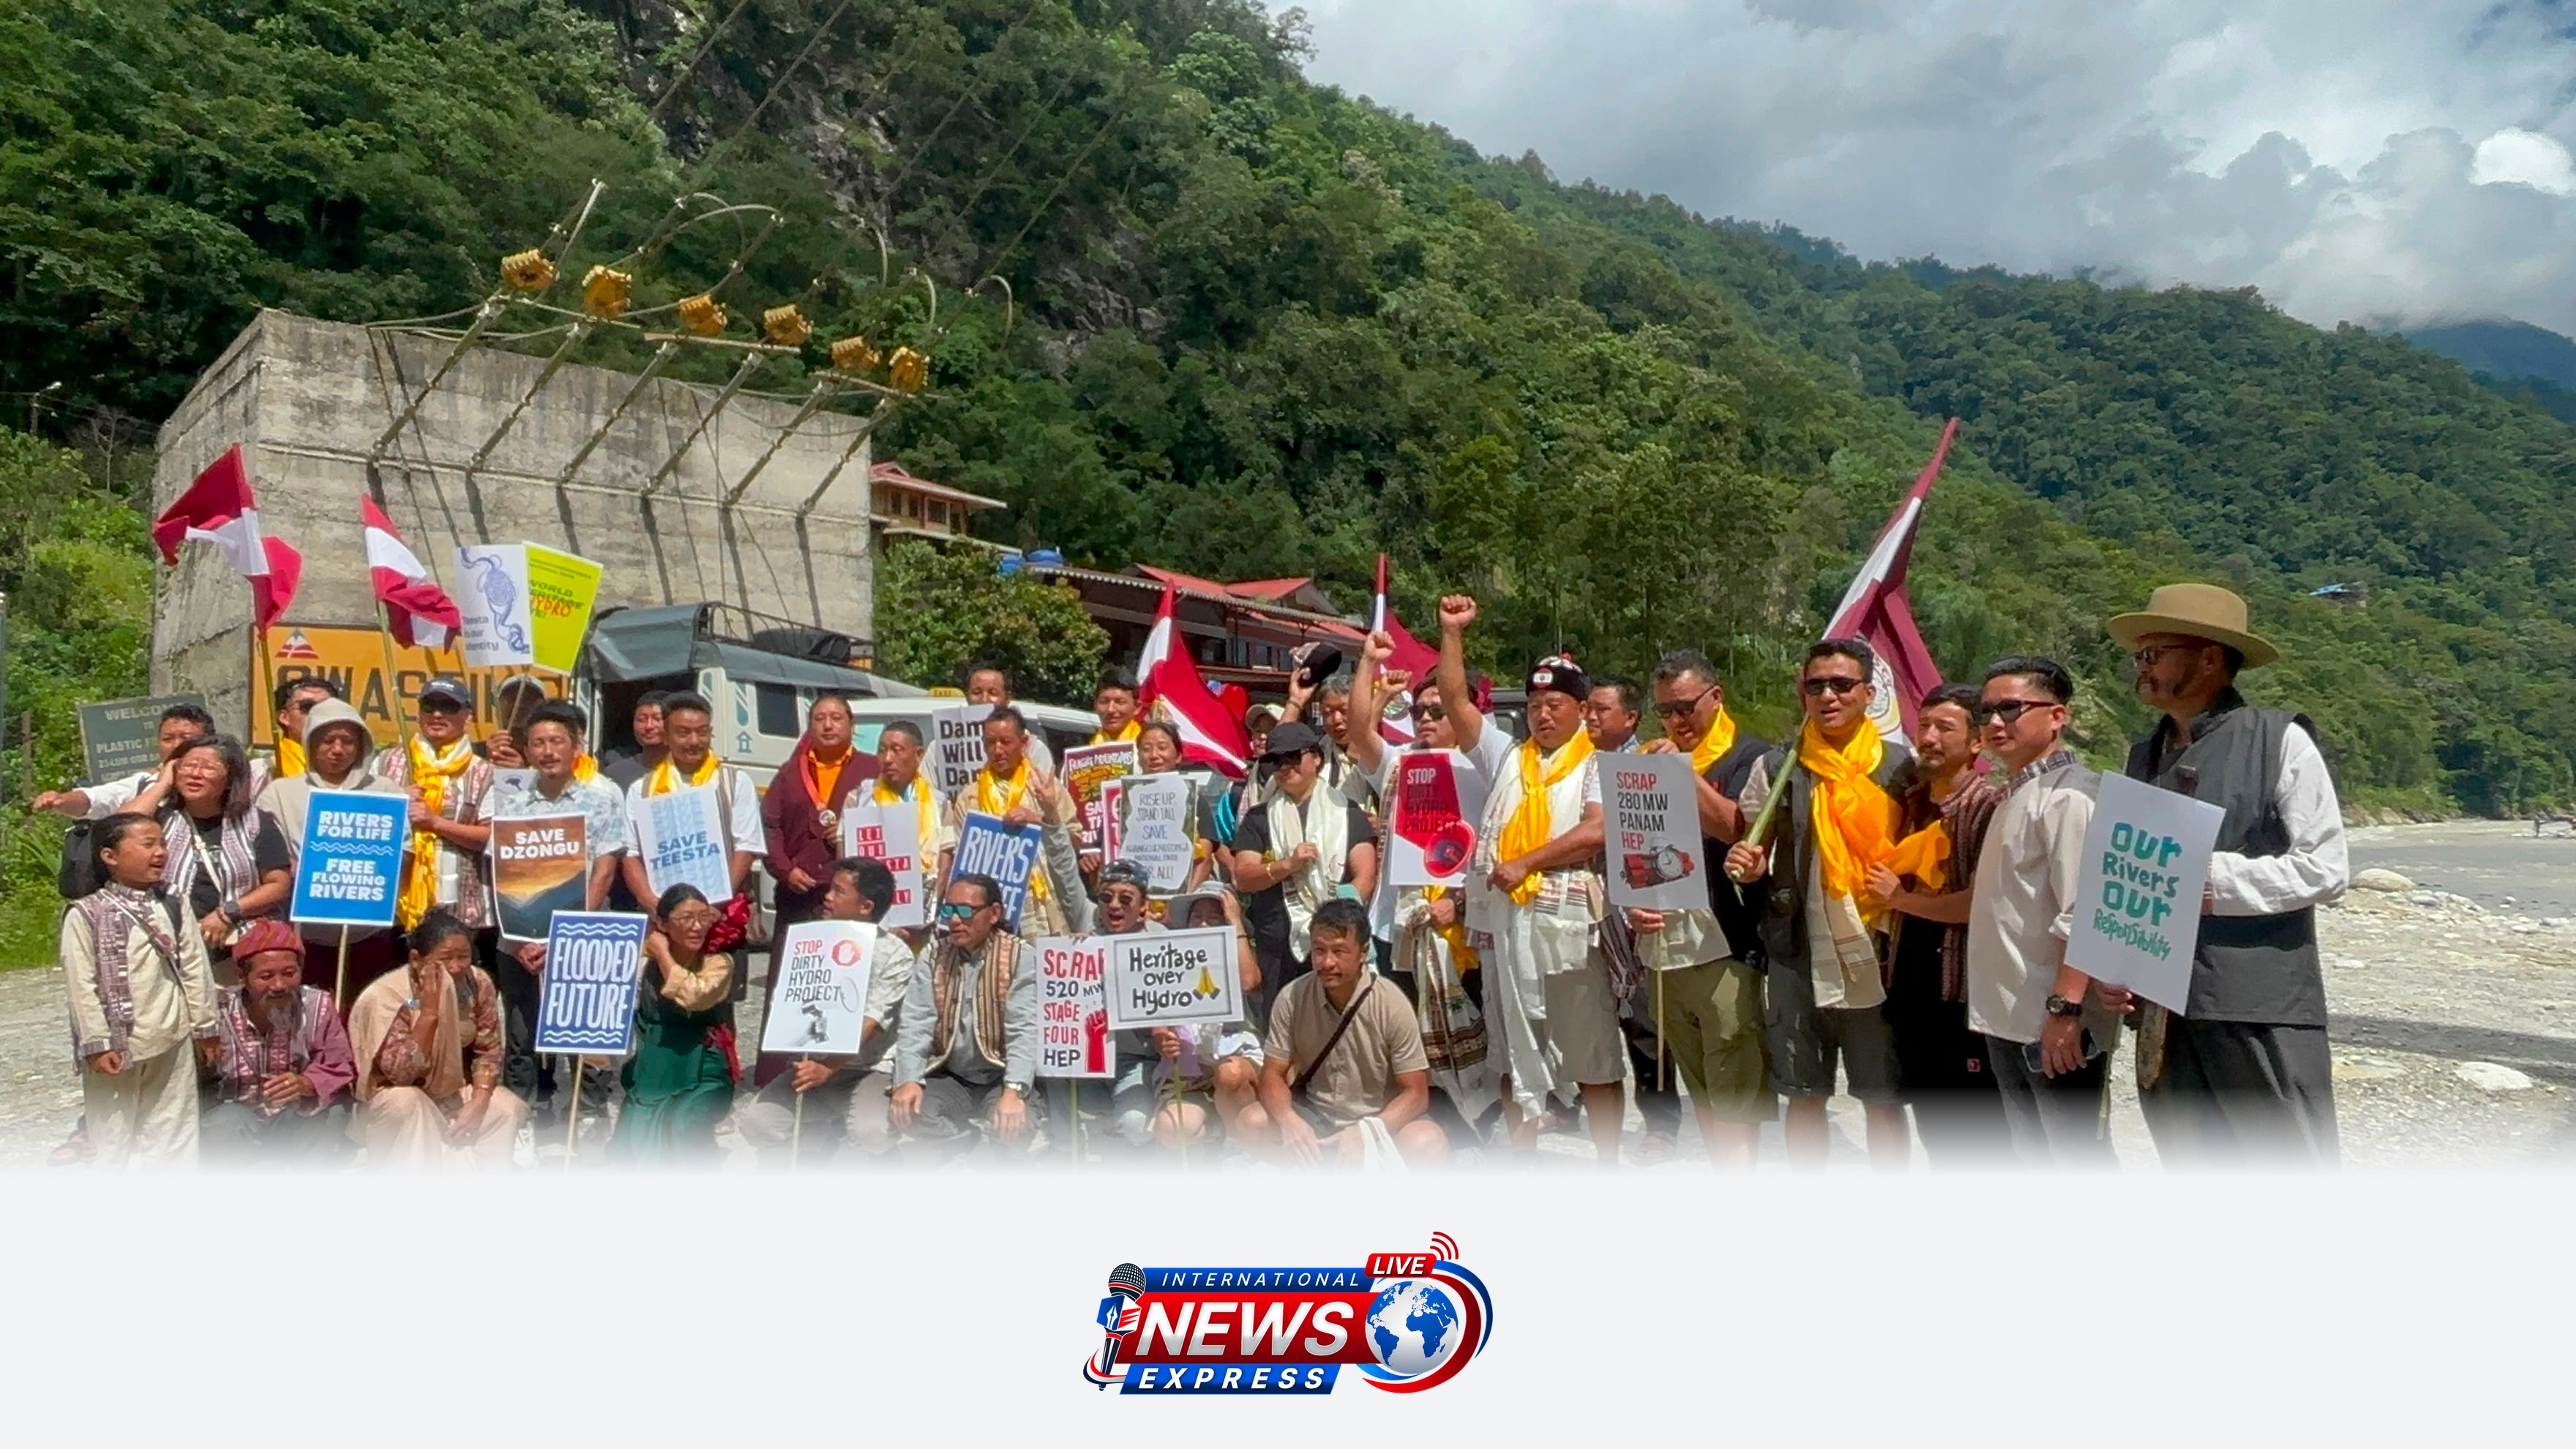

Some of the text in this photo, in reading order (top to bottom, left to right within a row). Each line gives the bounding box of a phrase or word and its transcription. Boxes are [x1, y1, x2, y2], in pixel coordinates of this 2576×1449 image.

[105, 703, 175, 721] WELCO
[96, 738, 143, 754] PLASTIC
[943, 741, 983, 763] Will
[1407, 768, 1437, 785] STOP
[1616, 771, 1657, 790] SCRAP
[1617, 792, 1669, 811] 280 MW
[318, 810, 393, 828] RIVERS
[1161, 807, 1175, 821] TALL
[1620, 812, 1665, 831] PANAM
[317, 825, 391, 841] FOR LIFE
[1142, 825, 1168, 839] SAVE
[1402, 816, 1459, 834] PROJECT
[515, 828, 564, 844] SAVE
[657, 831, 708, 854] SAVE
[858, 828, 881, 841] LET
[1621, 831, 1644, 850] HEP
[500, 842, 580, 860] DZONGU
[650, 842, 720, 870] TEESTA
[326, 857, 376, 875] FREE
[2103, 851, 2179, 899] Rivers
[312, 872, 386, 886] FLOWING
[310, 883, 384, 902] RIVERS
[794, 939, 823, 955] STOP
[552, 937, 637, 982] FLOODED
[791, 954, 825, 970] DIRTY
[1128, 941, 1208, 972] Heritage
[788, 969, 831, 986] HYDRO
[1143, 970, 1185, 986] over
[785, 986, 841, 1003] PROJECT
[1046, 980, 1079, 998] 520
[546, 982, 631, 1029] FUTURE
[1044, 1000, 1079, 1022] STAGE
[1133, 989, 1192, 1016] Hydro
[1044, 1026, 1079, 1045] FOUR
[1043, 1048, 1080, 1068] HEP
